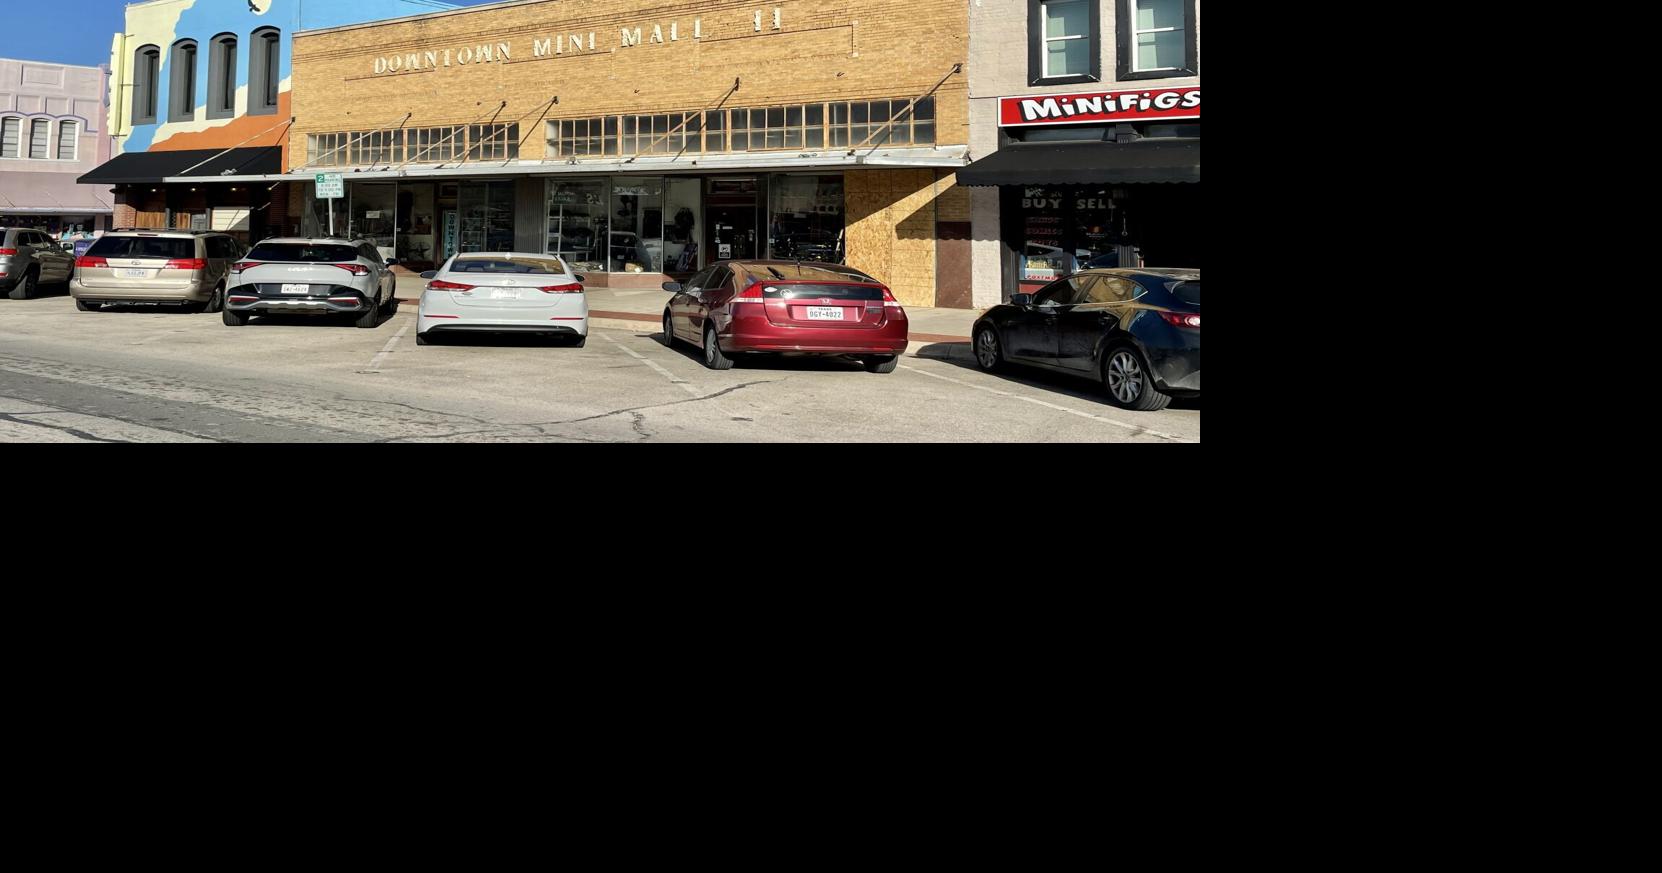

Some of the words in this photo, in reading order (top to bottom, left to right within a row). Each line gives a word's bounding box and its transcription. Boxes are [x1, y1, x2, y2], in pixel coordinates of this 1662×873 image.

[374, 41, 511, 75] DOWNTOWN
[533, 31, 596, 57] MINI
[620, 17, 711, 47] MALL
[1022, 198, 1063, 209] BUY
[1076, 198, 1118, 209] SELL
